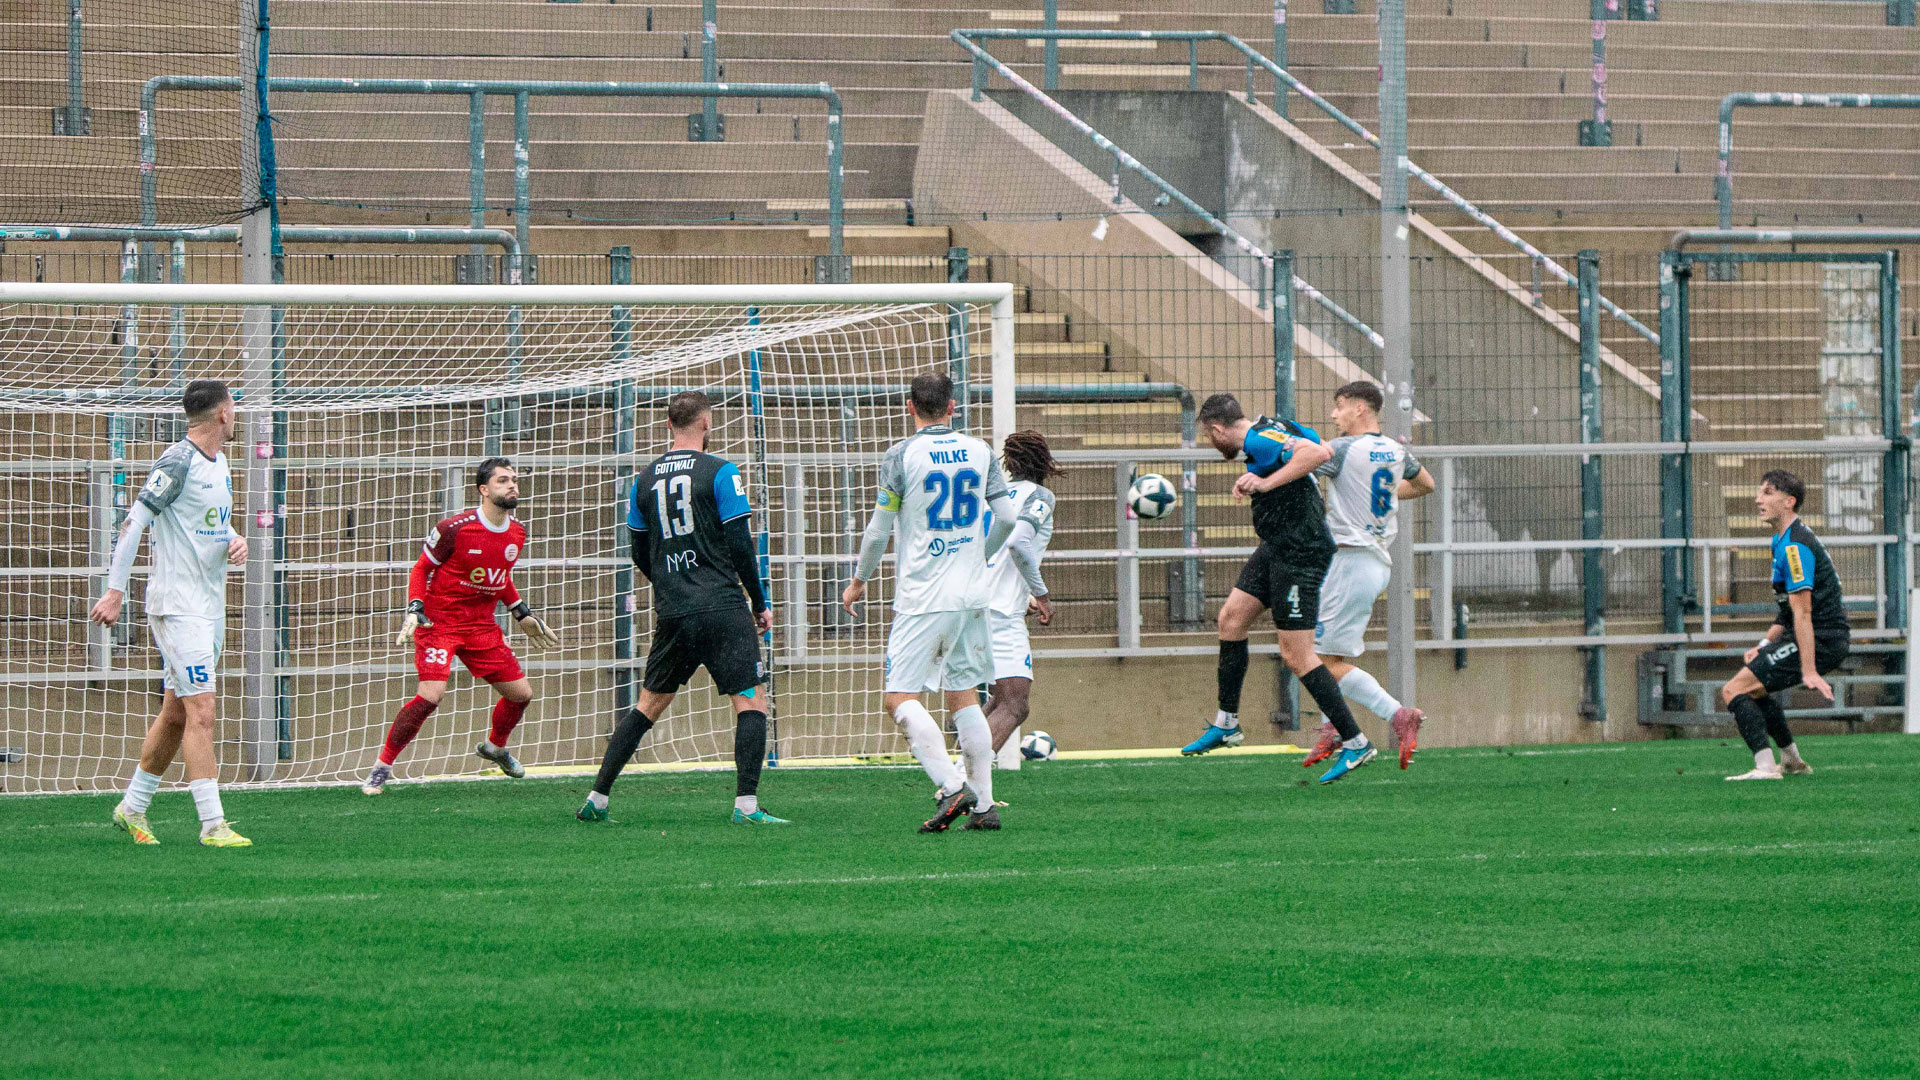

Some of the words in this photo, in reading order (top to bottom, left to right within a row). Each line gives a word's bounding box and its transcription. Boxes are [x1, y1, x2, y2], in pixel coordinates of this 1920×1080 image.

[929, 449, 969, 464] WILKE
[655, 459, 697, 475] GOTTWALT
[923, 467, 981, 531] 26
[1370, 467, 1394, 518] 6
[650, 474, 695, 540] 13
[1287, 584, 1301, 608] 4
[425, 647, 448, 666] 33
[1024, 653, 1032, 670] 4
[185, 665, 209, 684] 15
